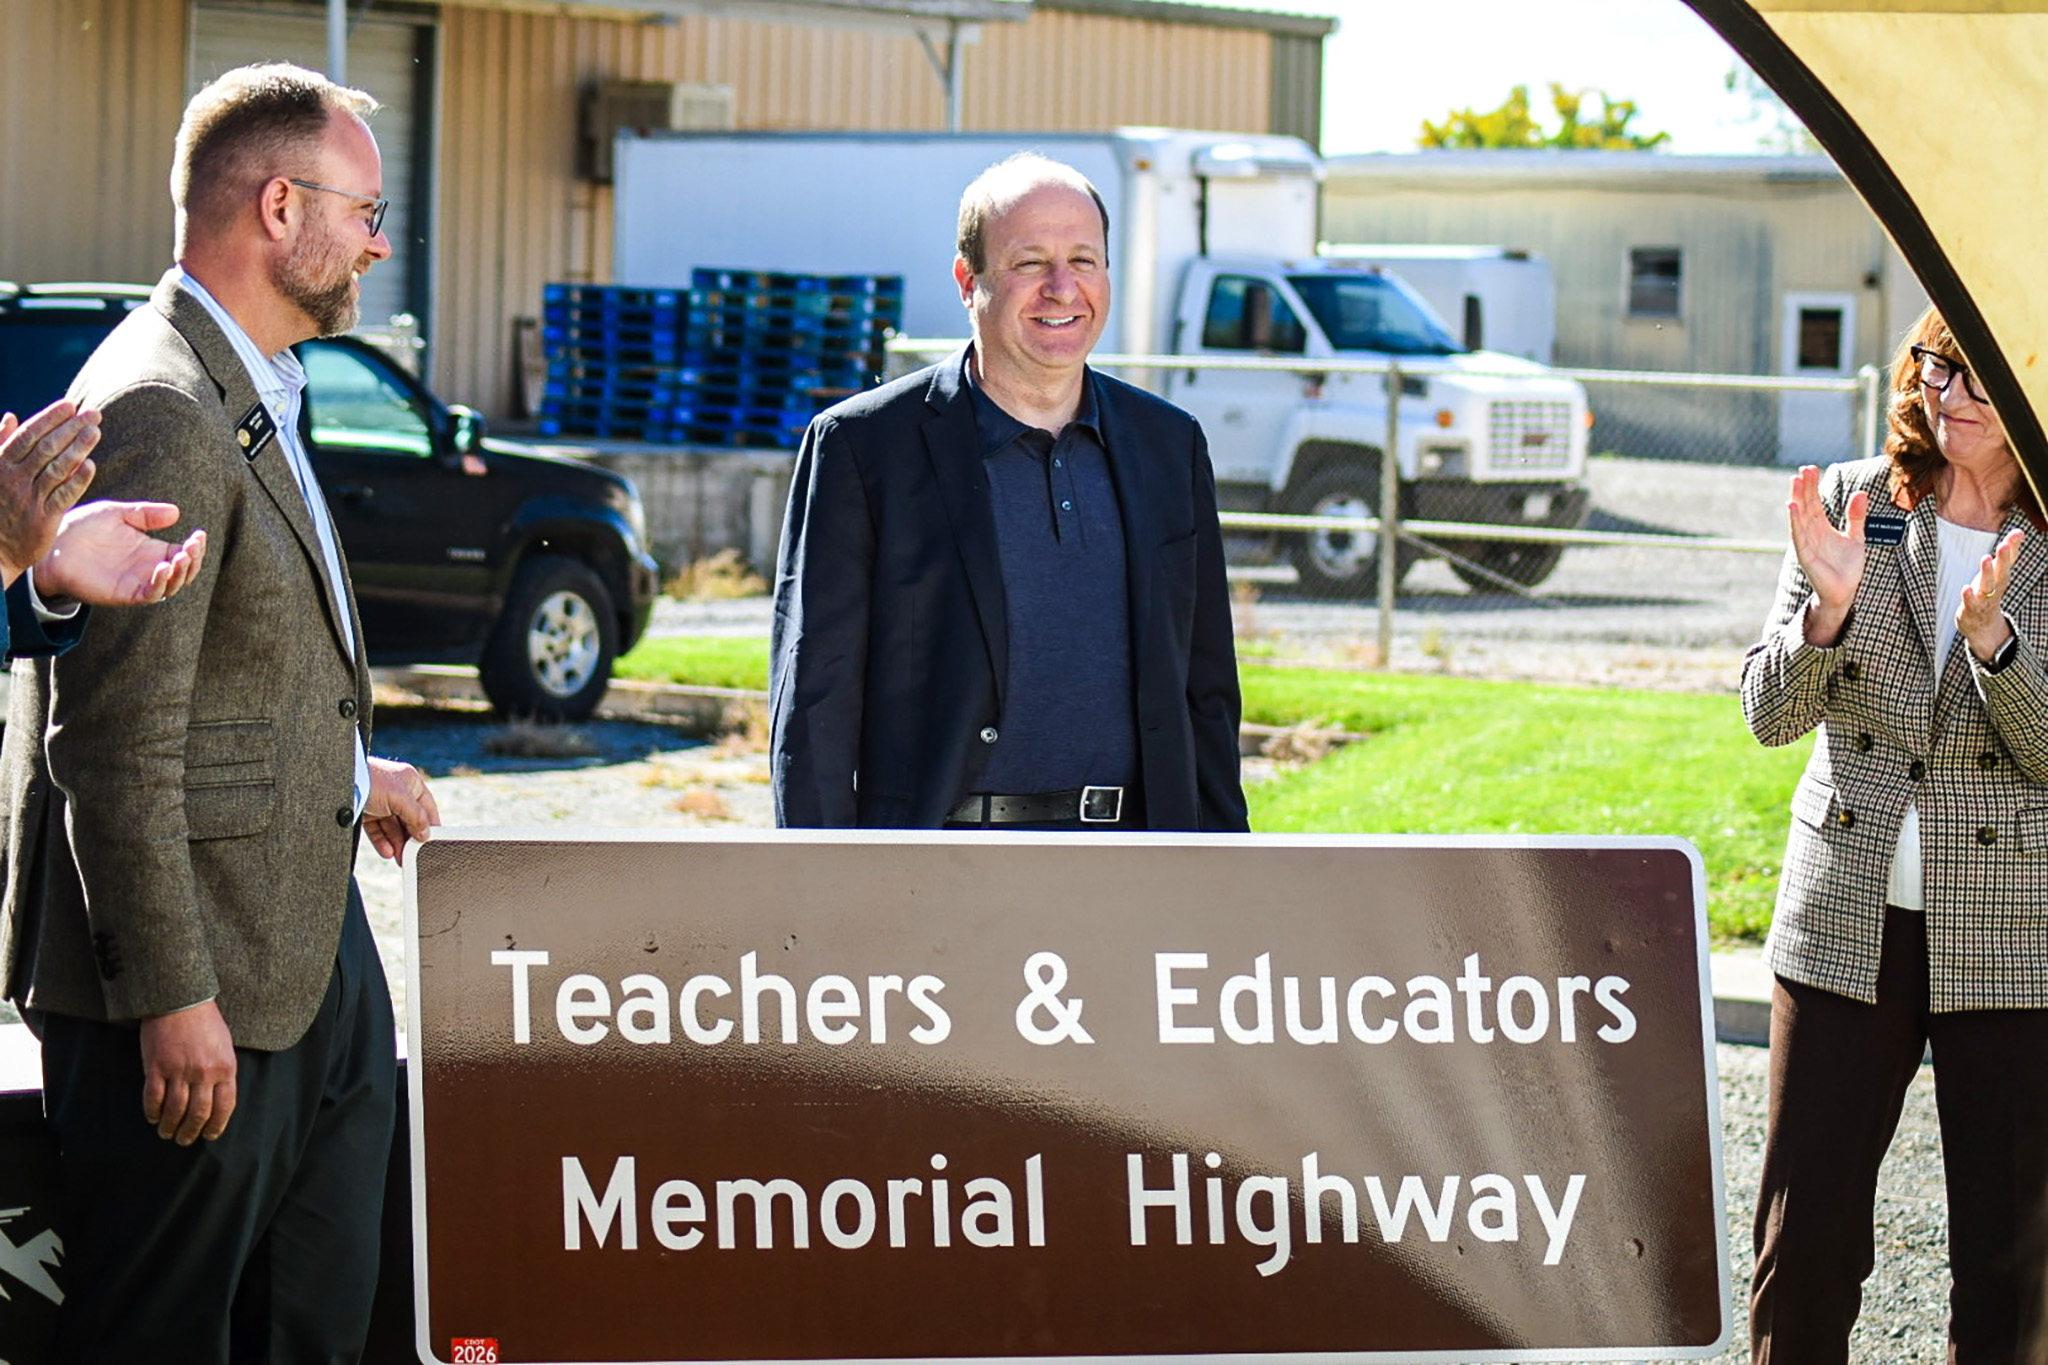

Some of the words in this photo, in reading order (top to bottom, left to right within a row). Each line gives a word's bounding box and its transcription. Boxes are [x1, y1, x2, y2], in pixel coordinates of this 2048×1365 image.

[491, 950, 952, 1045] Teachers
[1015, 951, 1095, 1045] &
[1155, 952, 1637, 1045] Educators
[562, 1153, 1045, 1250] Memorial
[1127, 1152, 1587, 1277] Highway
[454, 1345, 497, 1364] 2026
